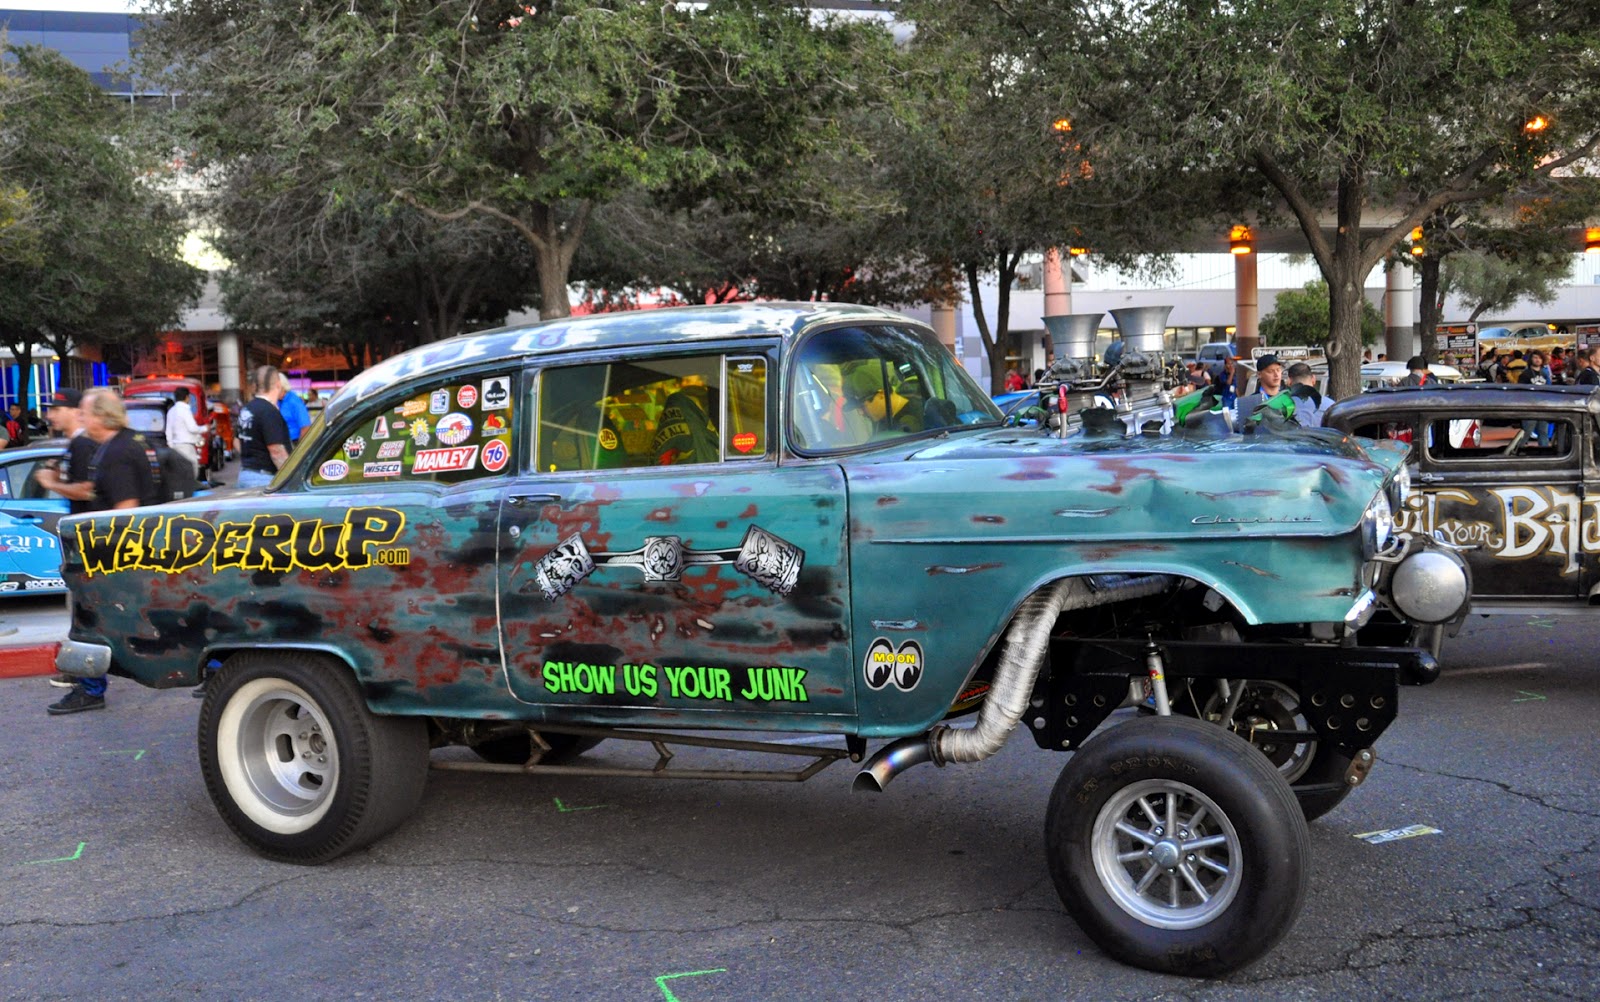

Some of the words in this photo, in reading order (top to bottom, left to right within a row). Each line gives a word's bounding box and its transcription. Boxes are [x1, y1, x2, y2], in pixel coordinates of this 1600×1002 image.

[414, 449, 469, 470] MANLEY
[486, 445, 504, 465] 76
[322, 463, 347, 477] NHRA
[364, 464, 400, 473] WISECO
[874, 653, 915, 664] MOON
[542, 660, 615, 694] SHOW
[622, 663, 658, 698] US
[664, 666, 733, 702] YOUR
[741, 667, 808, 702] JUNK
